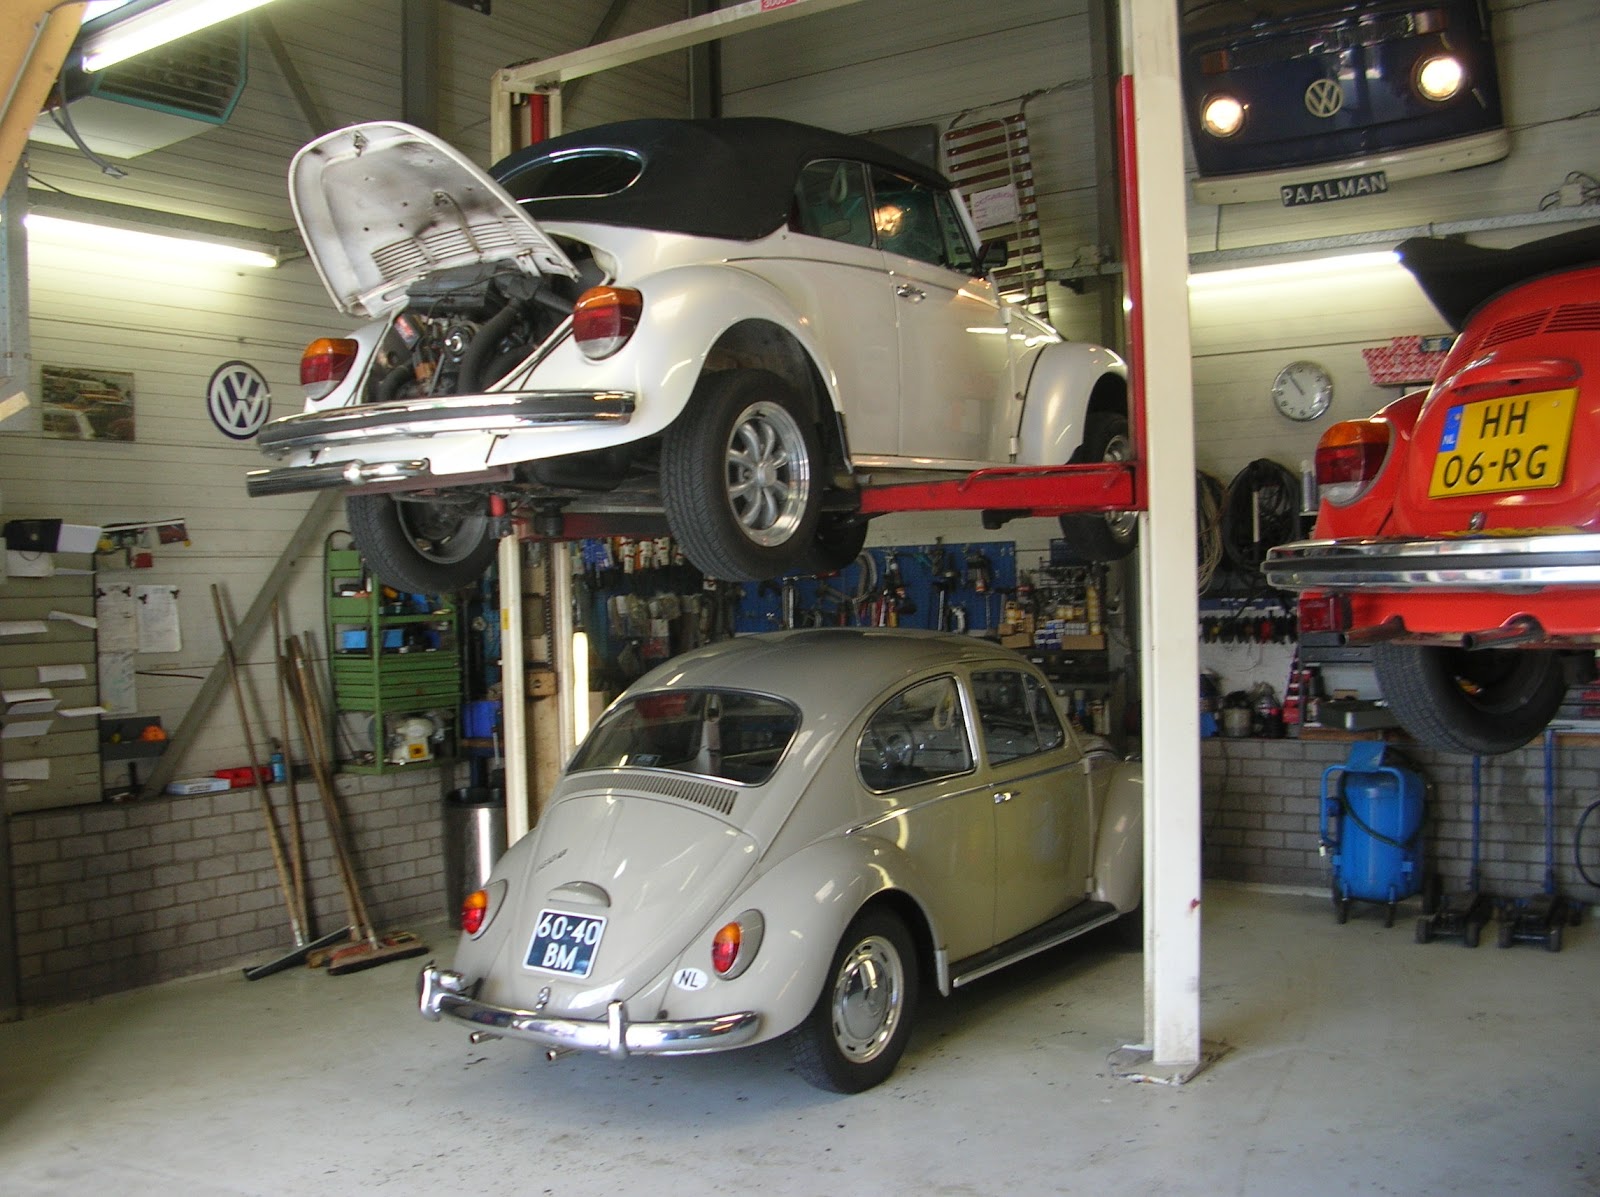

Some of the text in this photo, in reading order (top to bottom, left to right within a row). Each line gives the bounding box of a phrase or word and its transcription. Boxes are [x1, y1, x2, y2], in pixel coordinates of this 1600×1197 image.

[1305, 79, 1342, 117] VW
[1282, 173, 1387, 205] PAALMAN
[209, 363, 269, 437] VW
[1479, 401, 1529, 439] HH
[1442, 434, 1455, 445] NL
[1443, 445, 1548, 488] 06-RG
[538, 914, 600, 946] 60-40
[541, 942, 579, 970] BM
[678, 970, 698, 988] NL
